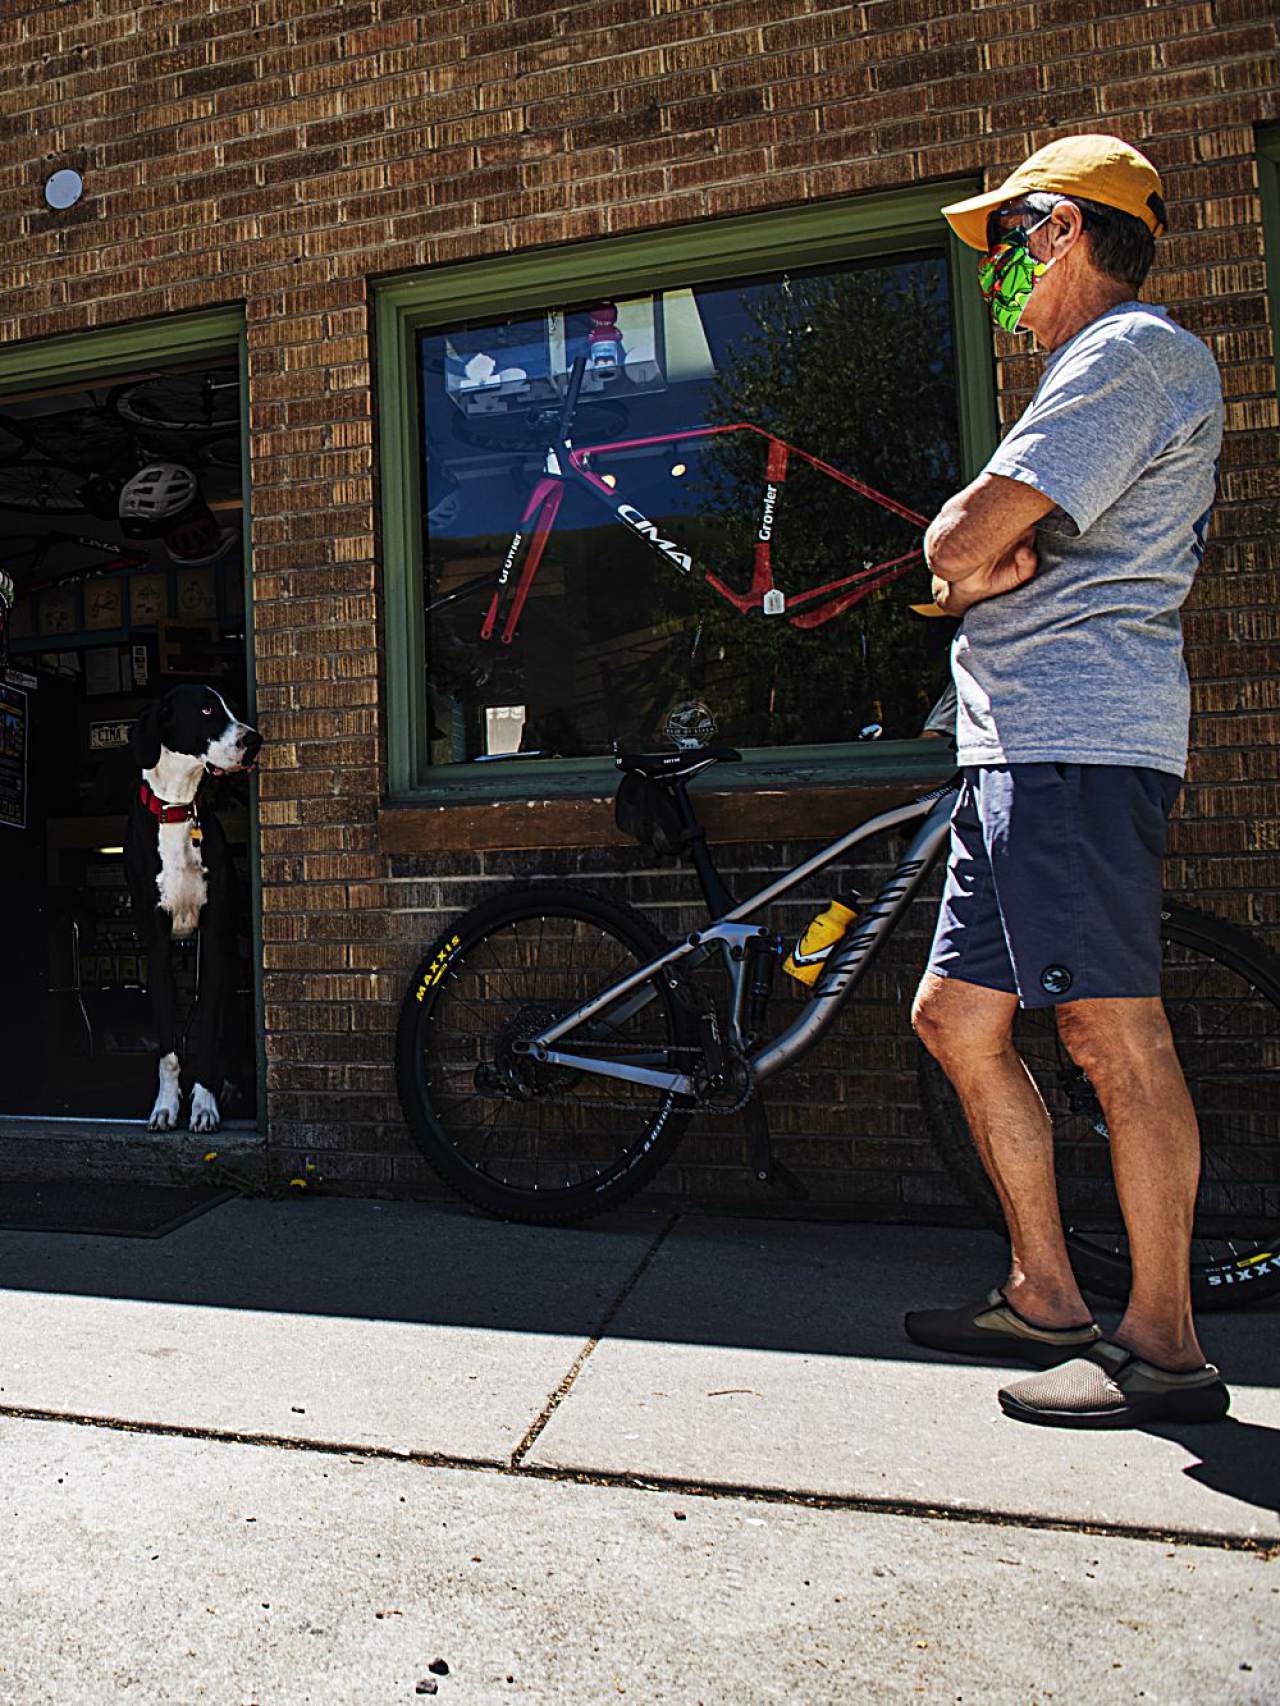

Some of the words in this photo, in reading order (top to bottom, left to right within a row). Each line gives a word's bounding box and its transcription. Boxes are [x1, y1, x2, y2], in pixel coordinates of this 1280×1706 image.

[617, 503, 694, 573] CIMA
[758, 483, 778, 542] Growler
[416, 935, 462, 1002] MAXXIS
